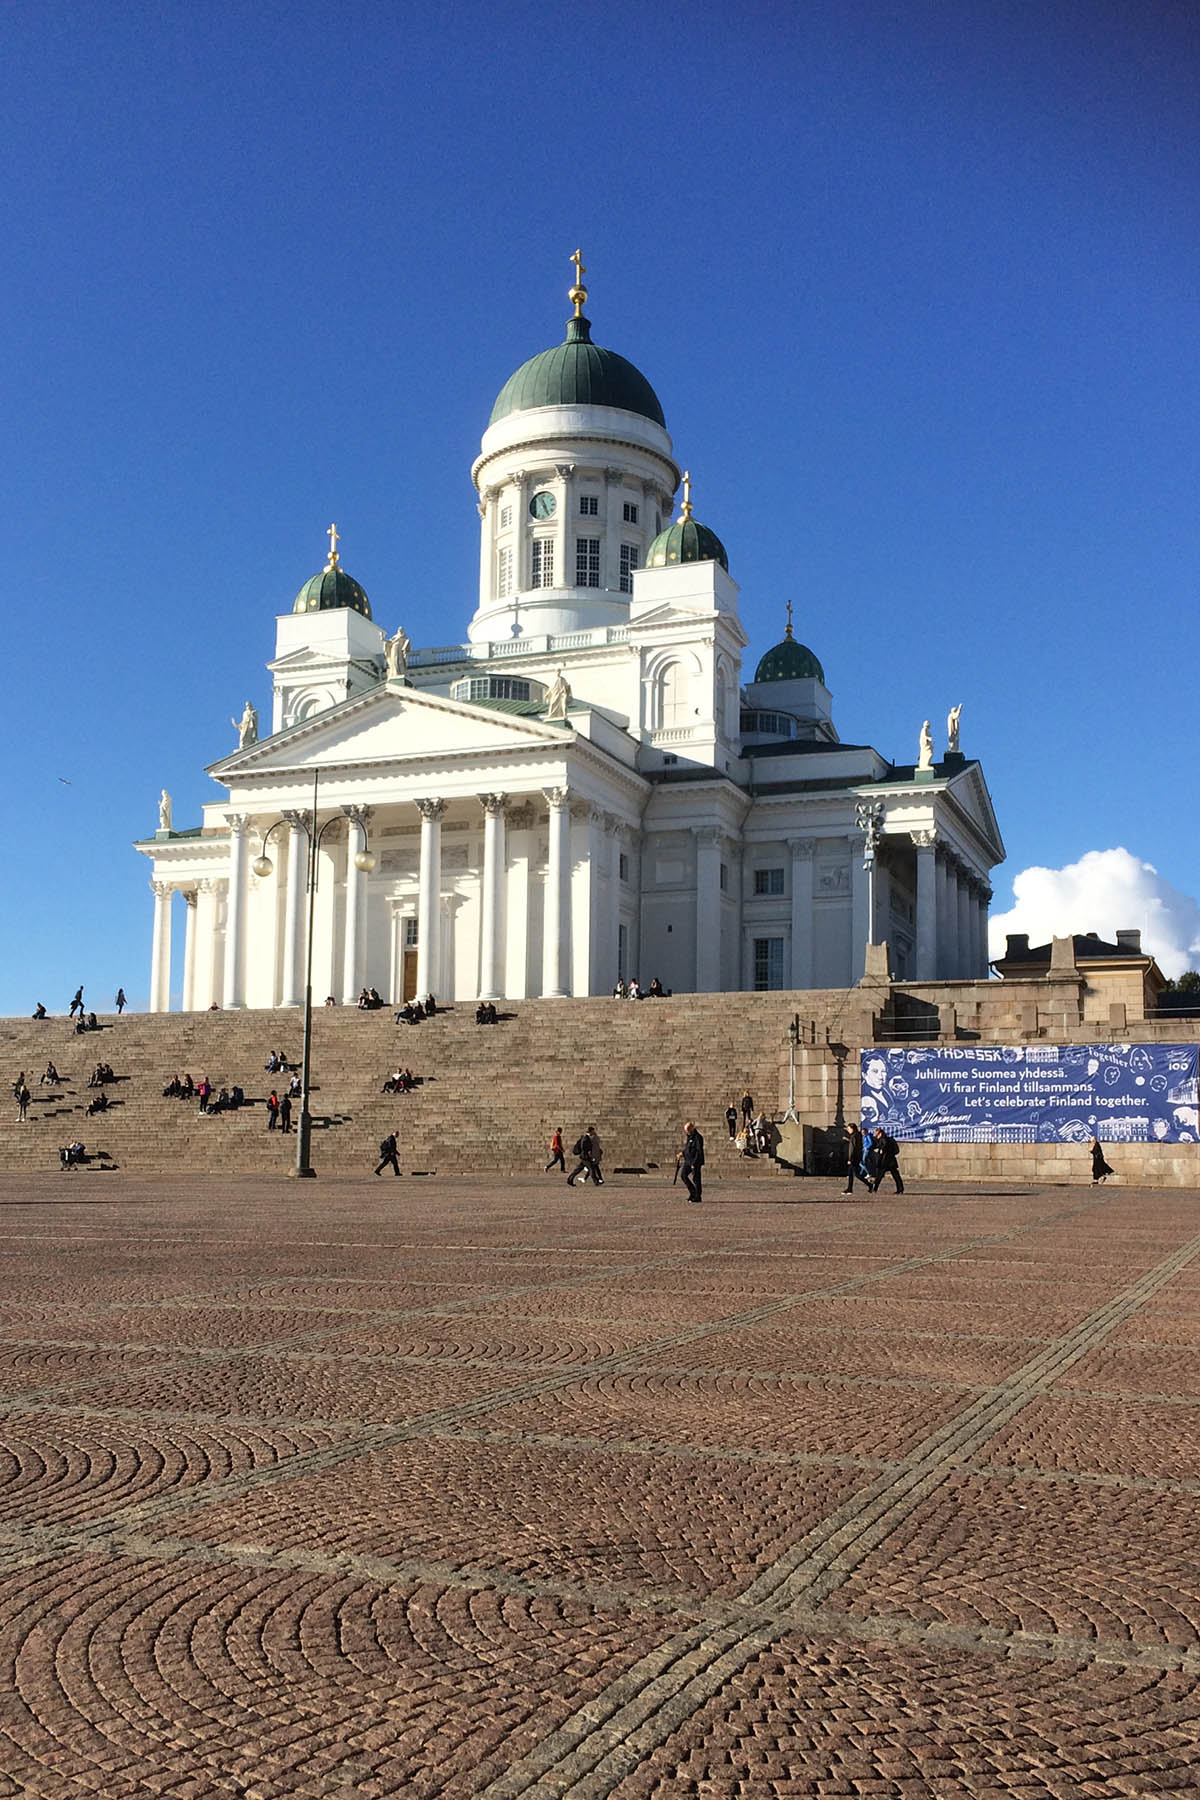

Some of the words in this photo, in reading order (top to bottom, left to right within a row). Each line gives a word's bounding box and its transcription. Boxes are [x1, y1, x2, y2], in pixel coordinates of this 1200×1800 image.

[1169, 1063, 1189, 1071] 100
[915, 1068, 968, 1079] Juhlimme
[971, 1068, 1016, 1079] Suomea
[1019, 1067, 1068, 1080] yhdessä.
[939, 1082, 950, 1093] Vi
[953, 1081, 976, 1092] firar
[979, 1081, 1020, 1092] Finland
[1024, 1081, 1096, 1092] tillsammans.
[965, 1096, 991, 1107] Let's
[993, 1095, 1046, 1107] celebrate
[1049, 1095, 1092, 1106] Finland
[1095, 1094, 1150, 1108] together.
